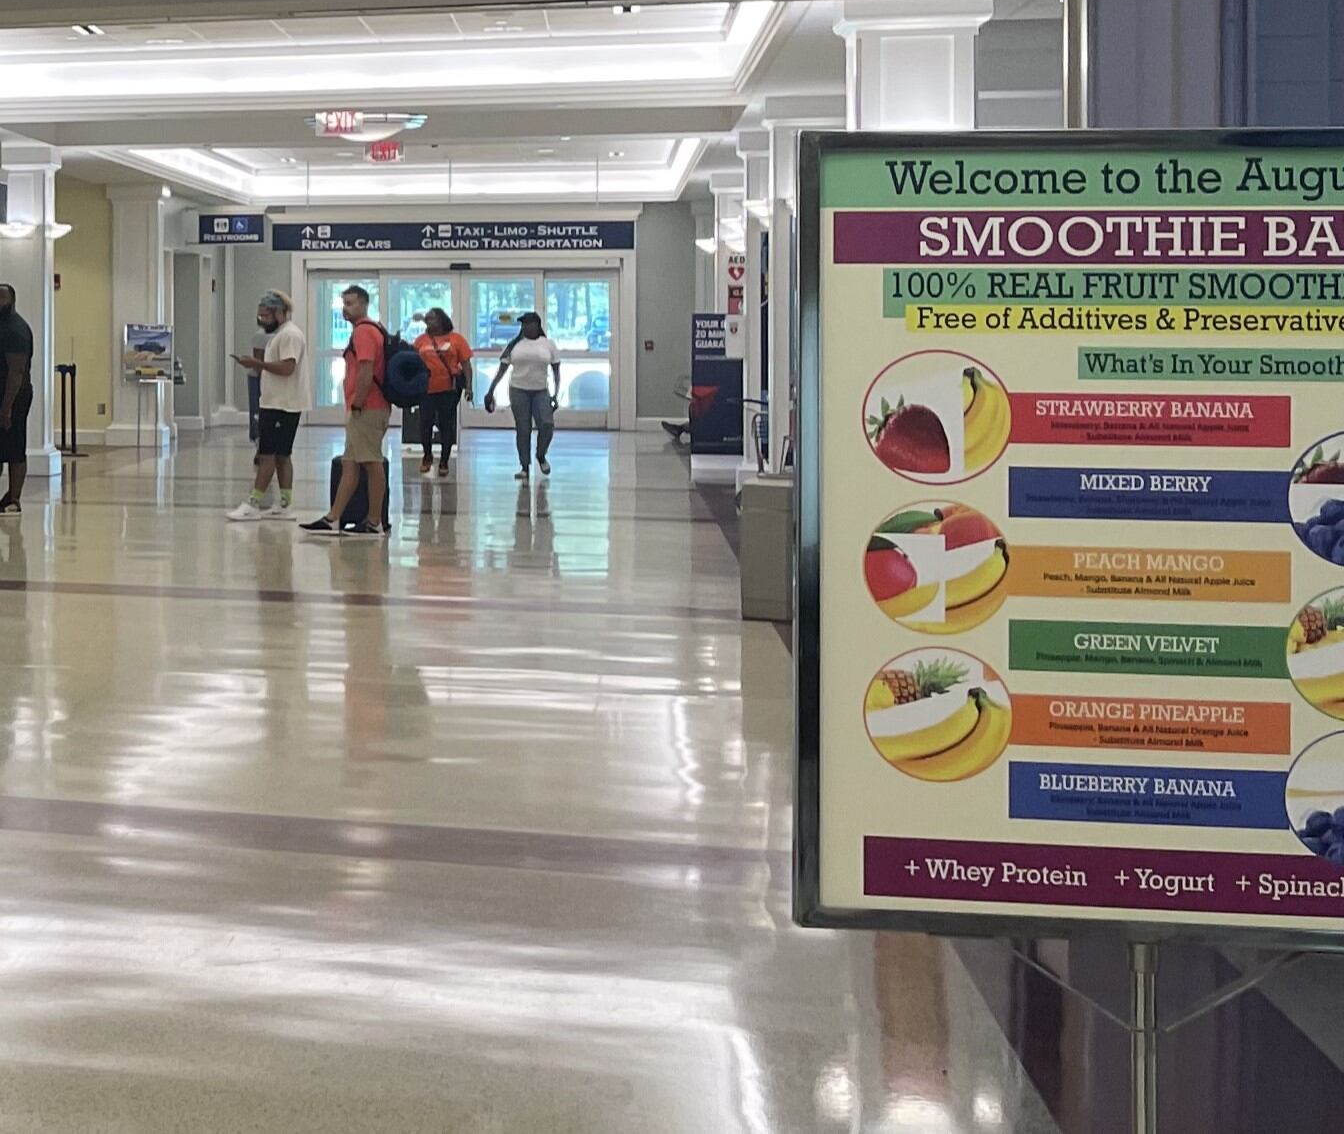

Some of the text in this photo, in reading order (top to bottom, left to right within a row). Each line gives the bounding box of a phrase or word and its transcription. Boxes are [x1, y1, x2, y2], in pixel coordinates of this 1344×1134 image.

[884, 159, 1087, 196] Welcome
[1100, 161, 1141, 195] to
[1154, 158, 1222, 195] the
[454, 226, 485, 236] TAXI
[494, 225, 528, 236] LIMO
[537, 225, 599, 236] SHUTTLE
[918, 215, 1344, 257] SMOOTHIE BA
[301, 239, 392, 250] RENTAL CARS
[421, 237, 603, 249] GROUND TRANSPORTATION
[892, 271, 1344, 300] 100% REAL FRUIT SMOOTH
[916, 306, 977, 330] Free
[985, 307, 1012, 330] of
[1017, 307, 1147, 330] Additives
[1155, 308, 1176, 331] &
[1084, 352, 1164, 375] What's
[1171, 353, 1194, 375] In
[1197, 353, 1253, 375] Your
[1035, 399, 1254, 419] STRAWBERRY BANANA
[1079, 473, 1212, 493] MIXED BERRY
[1073, 552, 1225, 573] PEACH MANGO
[1073, 633, 1220, 654] GREEN VELVET
[1048, 700, 1246, 724] ORANGE PINEAPPLE
[1039, 773, 1237, 797] BLUEBERRY BANANA
[924, 857, 995, 888] Whey
[1001, 862, 1088, 887] Protein
[1135, 868, 1215, 897] Yogurt
